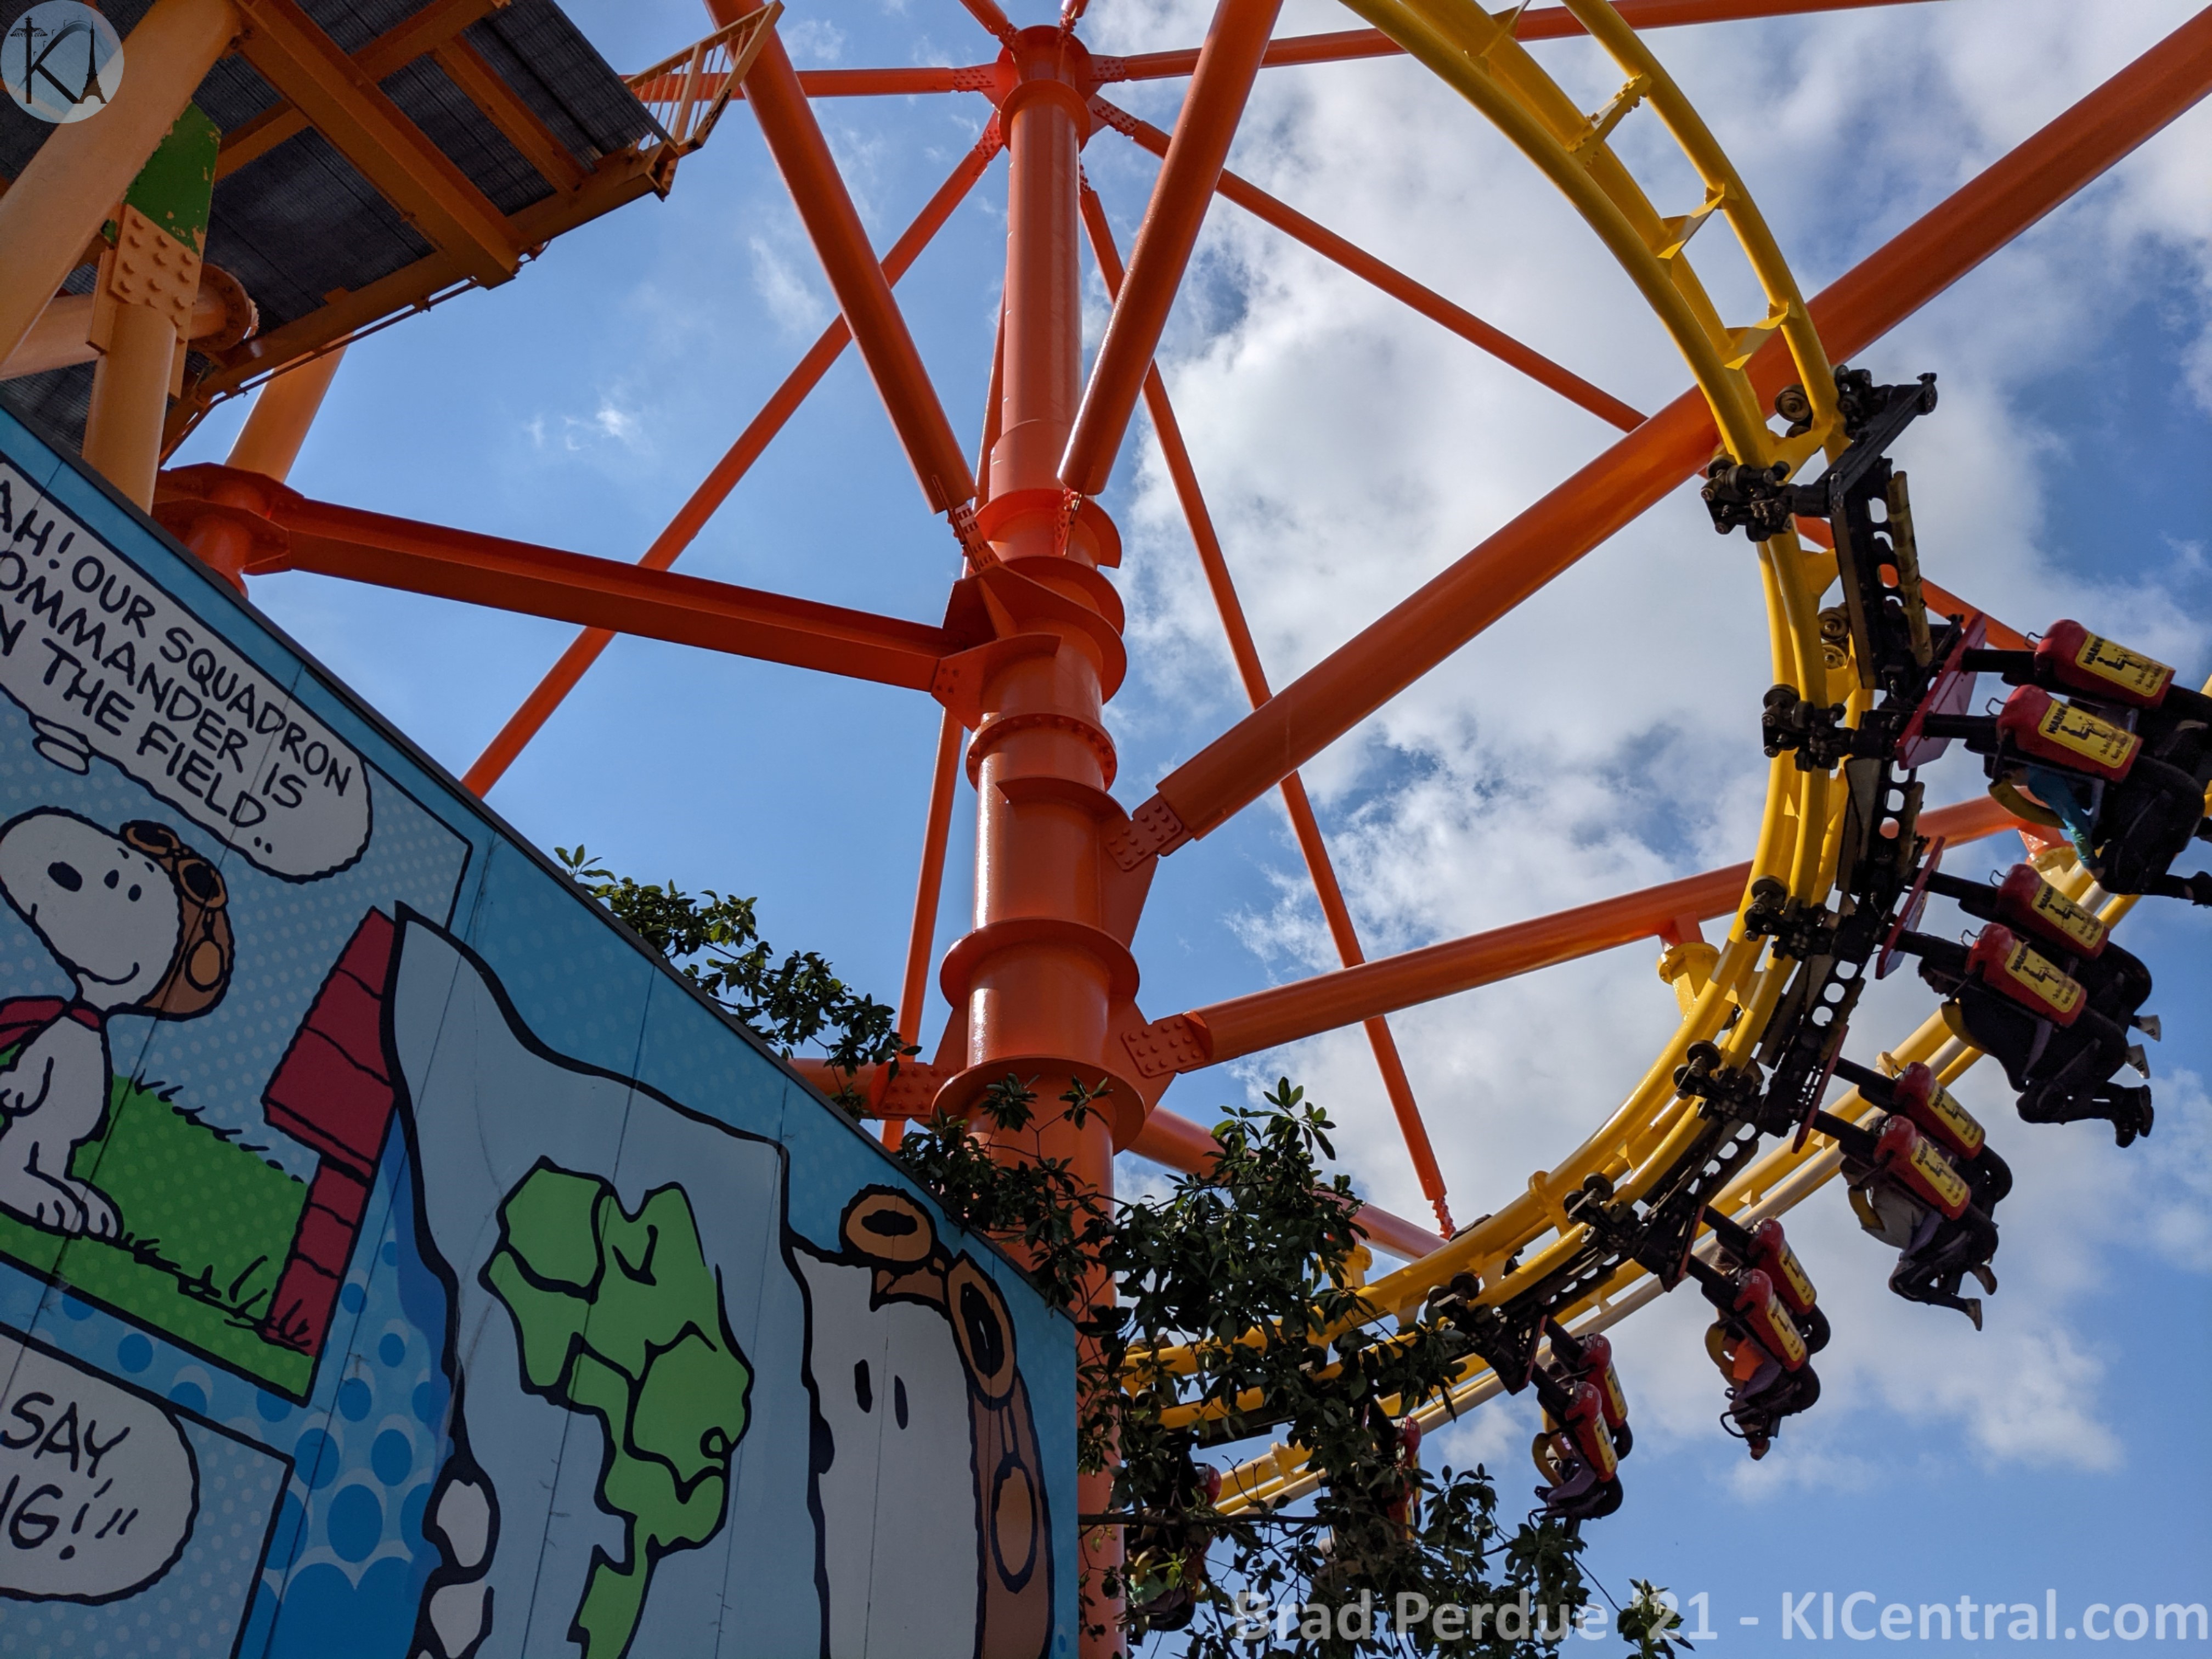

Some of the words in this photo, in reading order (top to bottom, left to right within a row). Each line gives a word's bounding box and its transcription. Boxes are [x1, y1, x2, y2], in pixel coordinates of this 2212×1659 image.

[42, 637, 135, 735] THE
[72, 556, 155, 638] OUR
[159, 627, 351, 796] SQUADRON
[262, 763, 307, 808] IS
